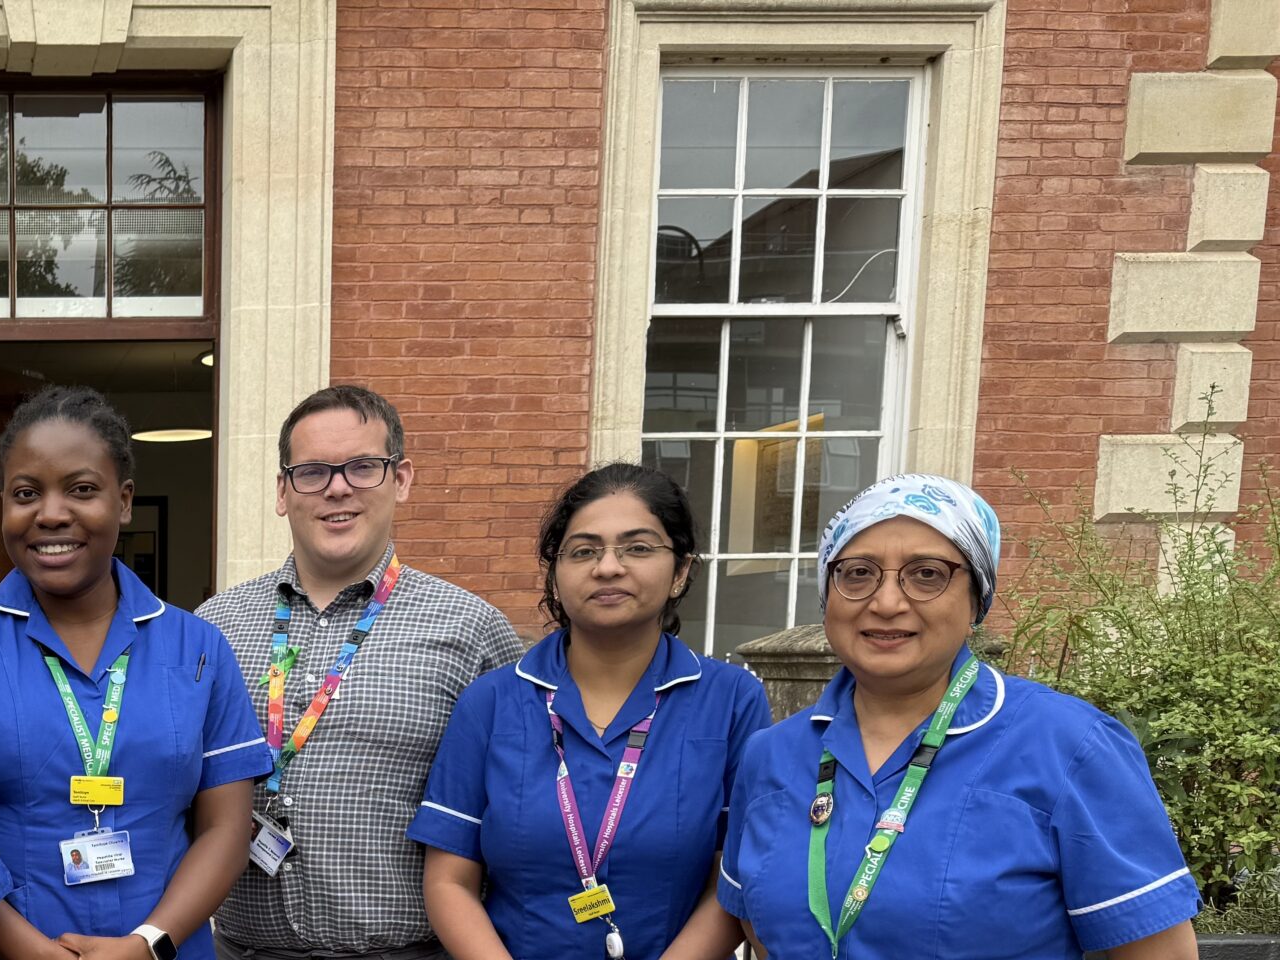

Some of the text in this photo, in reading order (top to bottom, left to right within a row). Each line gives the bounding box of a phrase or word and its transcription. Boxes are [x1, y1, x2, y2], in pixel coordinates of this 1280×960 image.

[64, 696, 87, 738] SPECIALIST
[559, 779, 588, 877] University Hospitals Leicester
[603, 807, 618, 839] Hospitals
[614, 778, 628, 807] Leicester
[573, 896, 611, 916] Sreelakshmi
